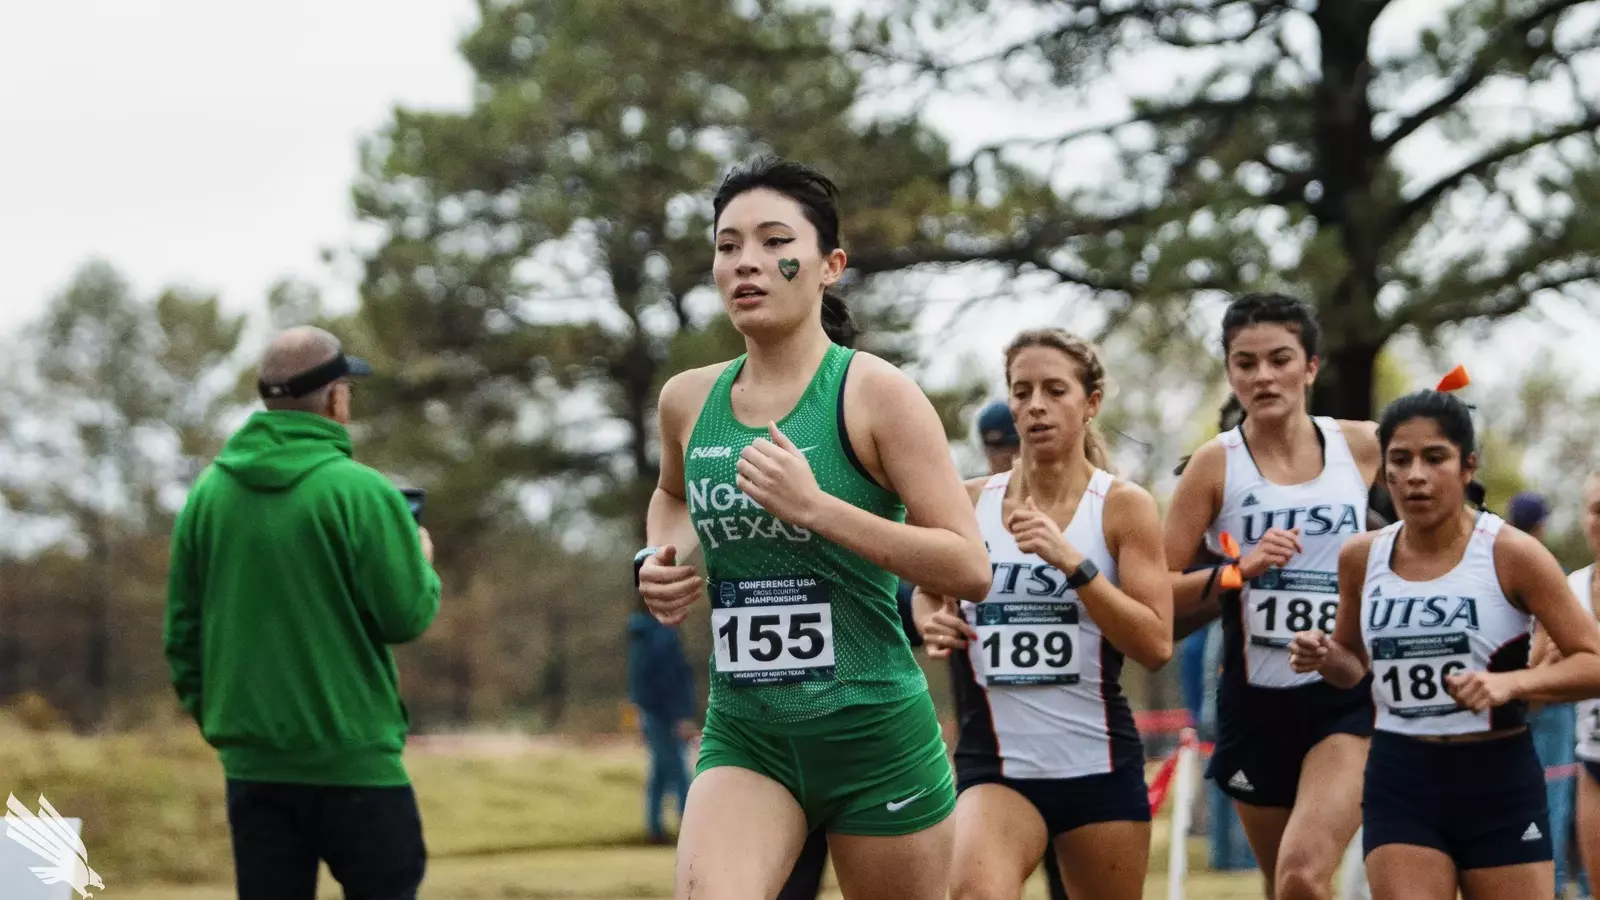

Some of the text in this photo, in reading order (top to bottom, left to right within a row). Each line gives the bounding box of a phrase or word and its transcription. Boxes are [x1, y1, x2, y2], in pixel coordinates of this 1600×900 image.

[697, 516, 811, 549] TEXAS
[1241, 504, 1360, 544] UTSA
[739, 578, 816, 590] CONFERENCE USA
[745, 595, 808, 604] CHAMPIONSHIPS
[1256, 596, 1339, 634] 188
[1367, 595, 1480, 631] UTSA
[719, 612, 824, 663] 155
[982, 631, 1073, 668] 189
